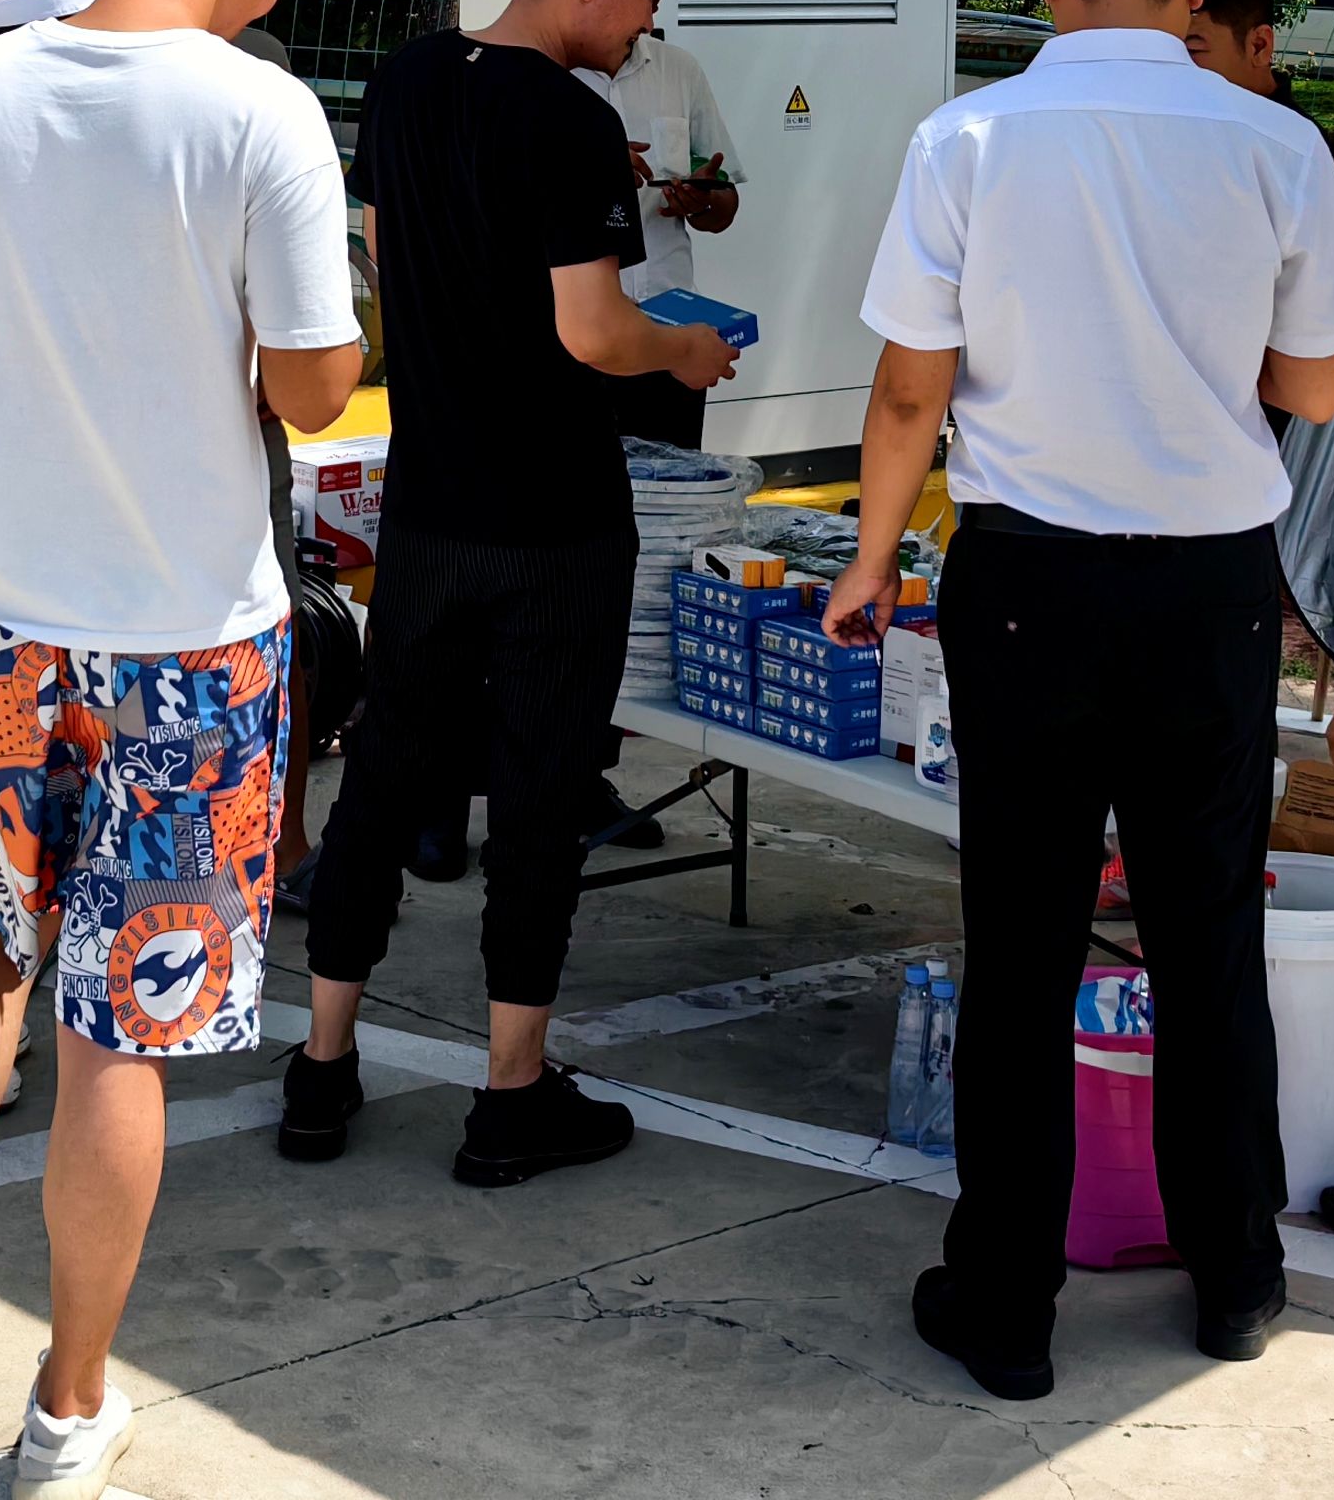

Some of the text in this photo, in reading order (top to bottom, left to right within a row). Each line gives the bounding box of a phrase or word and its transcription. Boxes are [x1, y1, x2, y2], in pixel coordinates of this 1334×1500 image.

[148, 716, 202, 745] YISILONG
[173, 814, 197, 880] YISILONG
[193, 815, 214, 877] YISILONG
